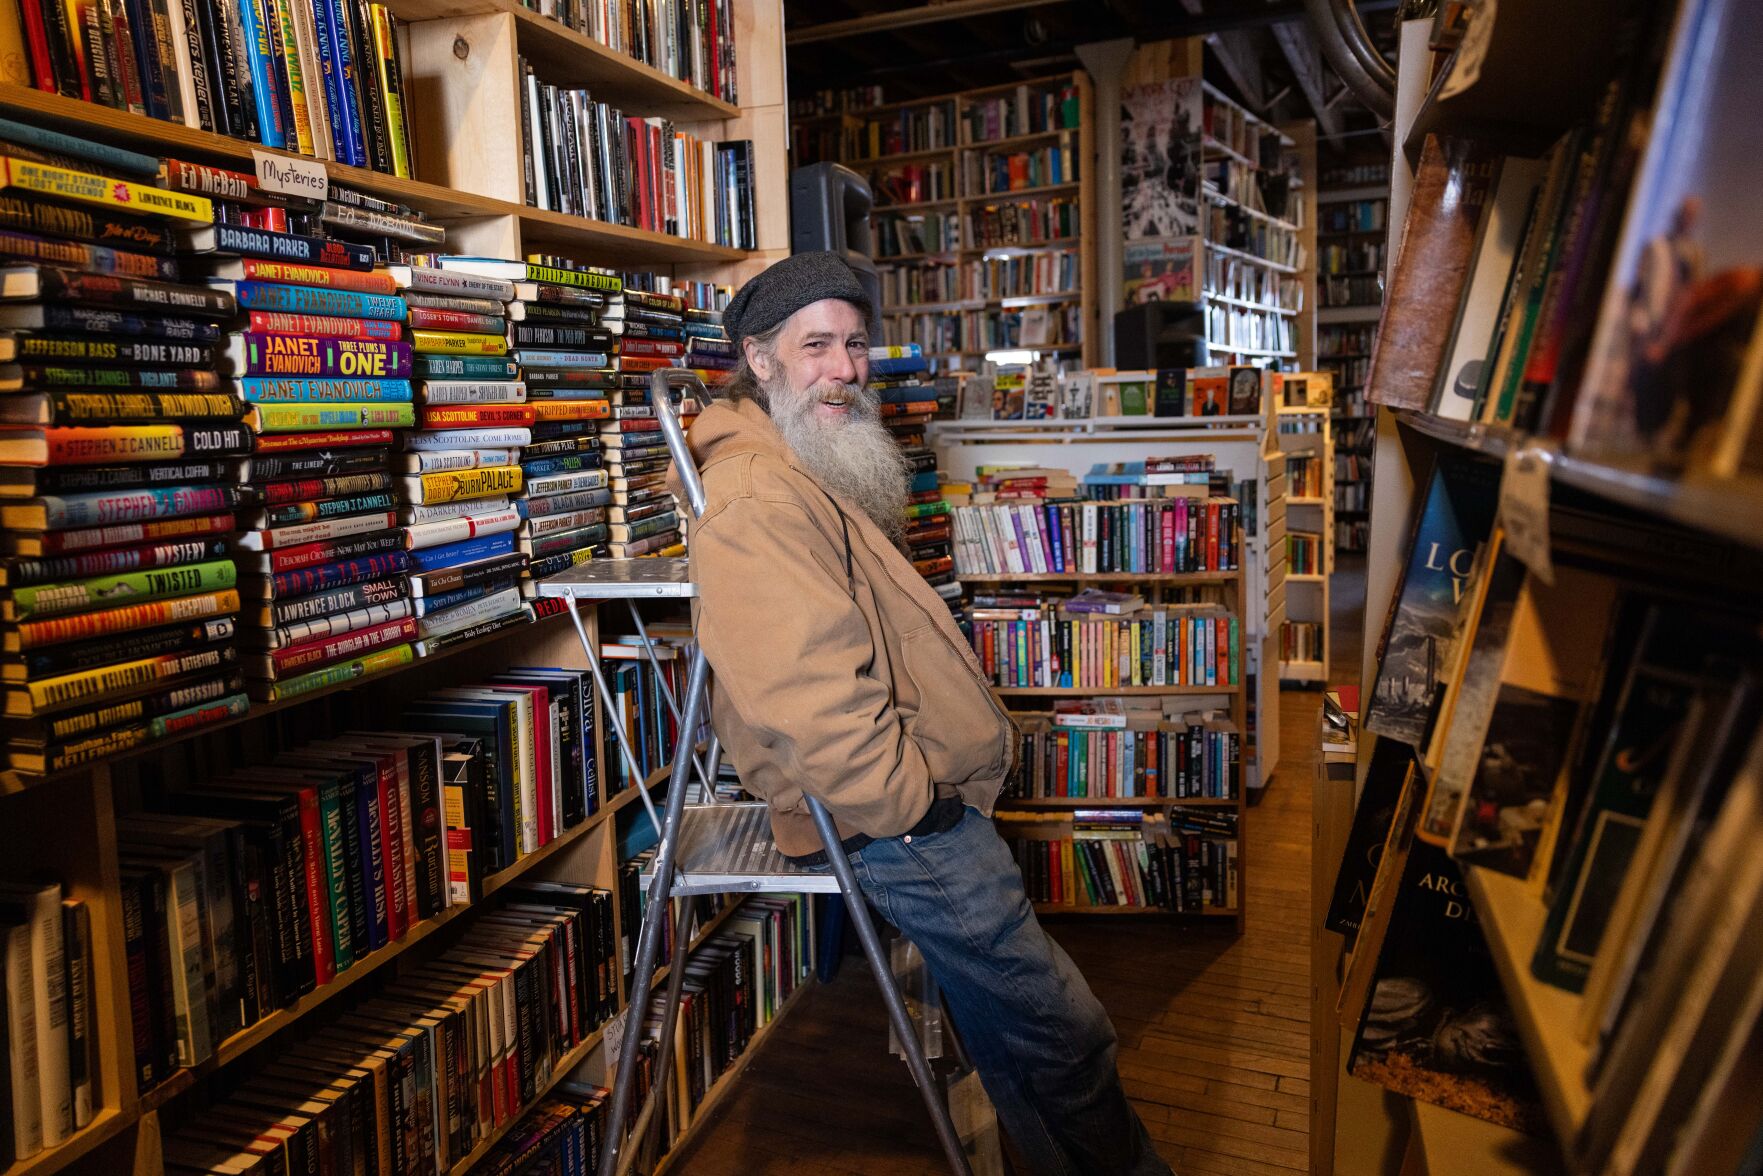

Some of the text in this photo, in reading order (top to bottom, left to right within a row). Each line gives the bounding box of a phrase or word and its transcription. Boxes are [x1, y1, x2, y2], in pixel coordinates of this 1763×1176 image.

[187, 29, 208, 107] lars kepler
[219, 15, 241, 106] FIVE-YEAR PLAN
[180, 162, 248, 201] Ed McBain
[262, 159, 326, 190] Mysteries
[138, 191, 197, 213] LAWRENCE BLOCK
[337, 206, 356, 225] Ed
[220, 227, 310, 259] BARBARA PARKER
[254, 262, 330, 285] JANET EVANOVICH
[416, 273, 438, 285] VINCE
[438, 276, 461, 288] FLYNN
[530, 266, 614, 290] PHILLIP MARGOLIN
[133, 287, 207, 308] MICHAEL CONNELLY
[250, 284, 363, 315] JANET EVANOVICH
[366, 295, 397, 320] TWELVE SHARP
[267, 312, 361, 337] JANET EVANOVICH
[419, 312, 460, 323] LOSER'S TOWN
[23, 338, 201, 363] JEFFERSON BASS BONE YARD
[265, 336, 319, 356] JANET
[338, 340, 387, 354] THREE PLUMS IN
[445, 338, 467, 349] PARKER
[265, 353, 321, 375] EVANOVICH
[340, 352, 387, 377] ONE
[428, 359, 465, 375] KAREN HARPER
[529, 372, 545, 380] BARBARA
[259, 379, 382, 401] JANET EVANOVICH
[426, 409, 525, 423] LISA SCOTTOLINE DEVIL'S CORNER
[536, 404, 568, 417] STRIPPED
[130, 435, 183, 452] CANNELL
[193, 429, 241, 451] COLD HIT
[414, 432, 522, 446] LISA SCOTTOLINE COME HOME
[561, 440, 576, 451] PLACE
[149, 464, 210, 481] VERTICAL COFFIN
[292, 459, 325, 471] THE LINEUP
[530, 462, 551, 473] PARKER
[426, 475, 455, 489] STEPHEN
[428, 485, 456, 501] DOBYNS
[459, 469, 515, 496] BURN PALACE
[535, 478, 558, 493] JEFFERSON
[557, 477, 573, 491] PARKER
[97, 487, 225, 524] STEPHEN CANNELL
[319, 494, 392, 516] STEPHEN CANNELL
[418, 502, 484, 520] A DARKER JUSTICE
[553, 495, 574, 511] BLACK
[575, 492, 595, 508] WATER
[303, 523, 331, 535] might be
[154, 541, 206, 566] MYSTERY
[279, 537, 396, 567] DEBORAH NOW MAY YOU WEEP
[145, 567, 202, 595] TWISTED
[276, 553, 396, 595] HOPE TO DIE
[430, 578, 439, 588] Tai
[438, 576, 447, 586] Chi
[446, 574, 463, 585] Chuan
[362, 579, 396, 595] SMALL
[364, 589, 399, 604] TOWN
[170, 595, 218, 620] DECEPTION
[278, 591, 357, 624] LAWRENCE BLOCK
[464, 622, 502, 639] Body Ecology Diet
[324, 644, 336, 658] THE
[369, 630, 381, 645] THE
[169, 679, 226, 707] OBSESSION
[583, 682, 595, 732] Silva
[417, 750, 432, 806] SANSOM
[586, 757, 597, 799] Cellist
[367, 798, 387, 926] McNALLY'S RISK
[387, 788, 407, 914] GUILTY PLEASURES
[424, 834, 439, 897] Revelation
[327, 807, 351, 951] McNALLY'S CAPER
[1419, 873, 1465, 898] ARC
